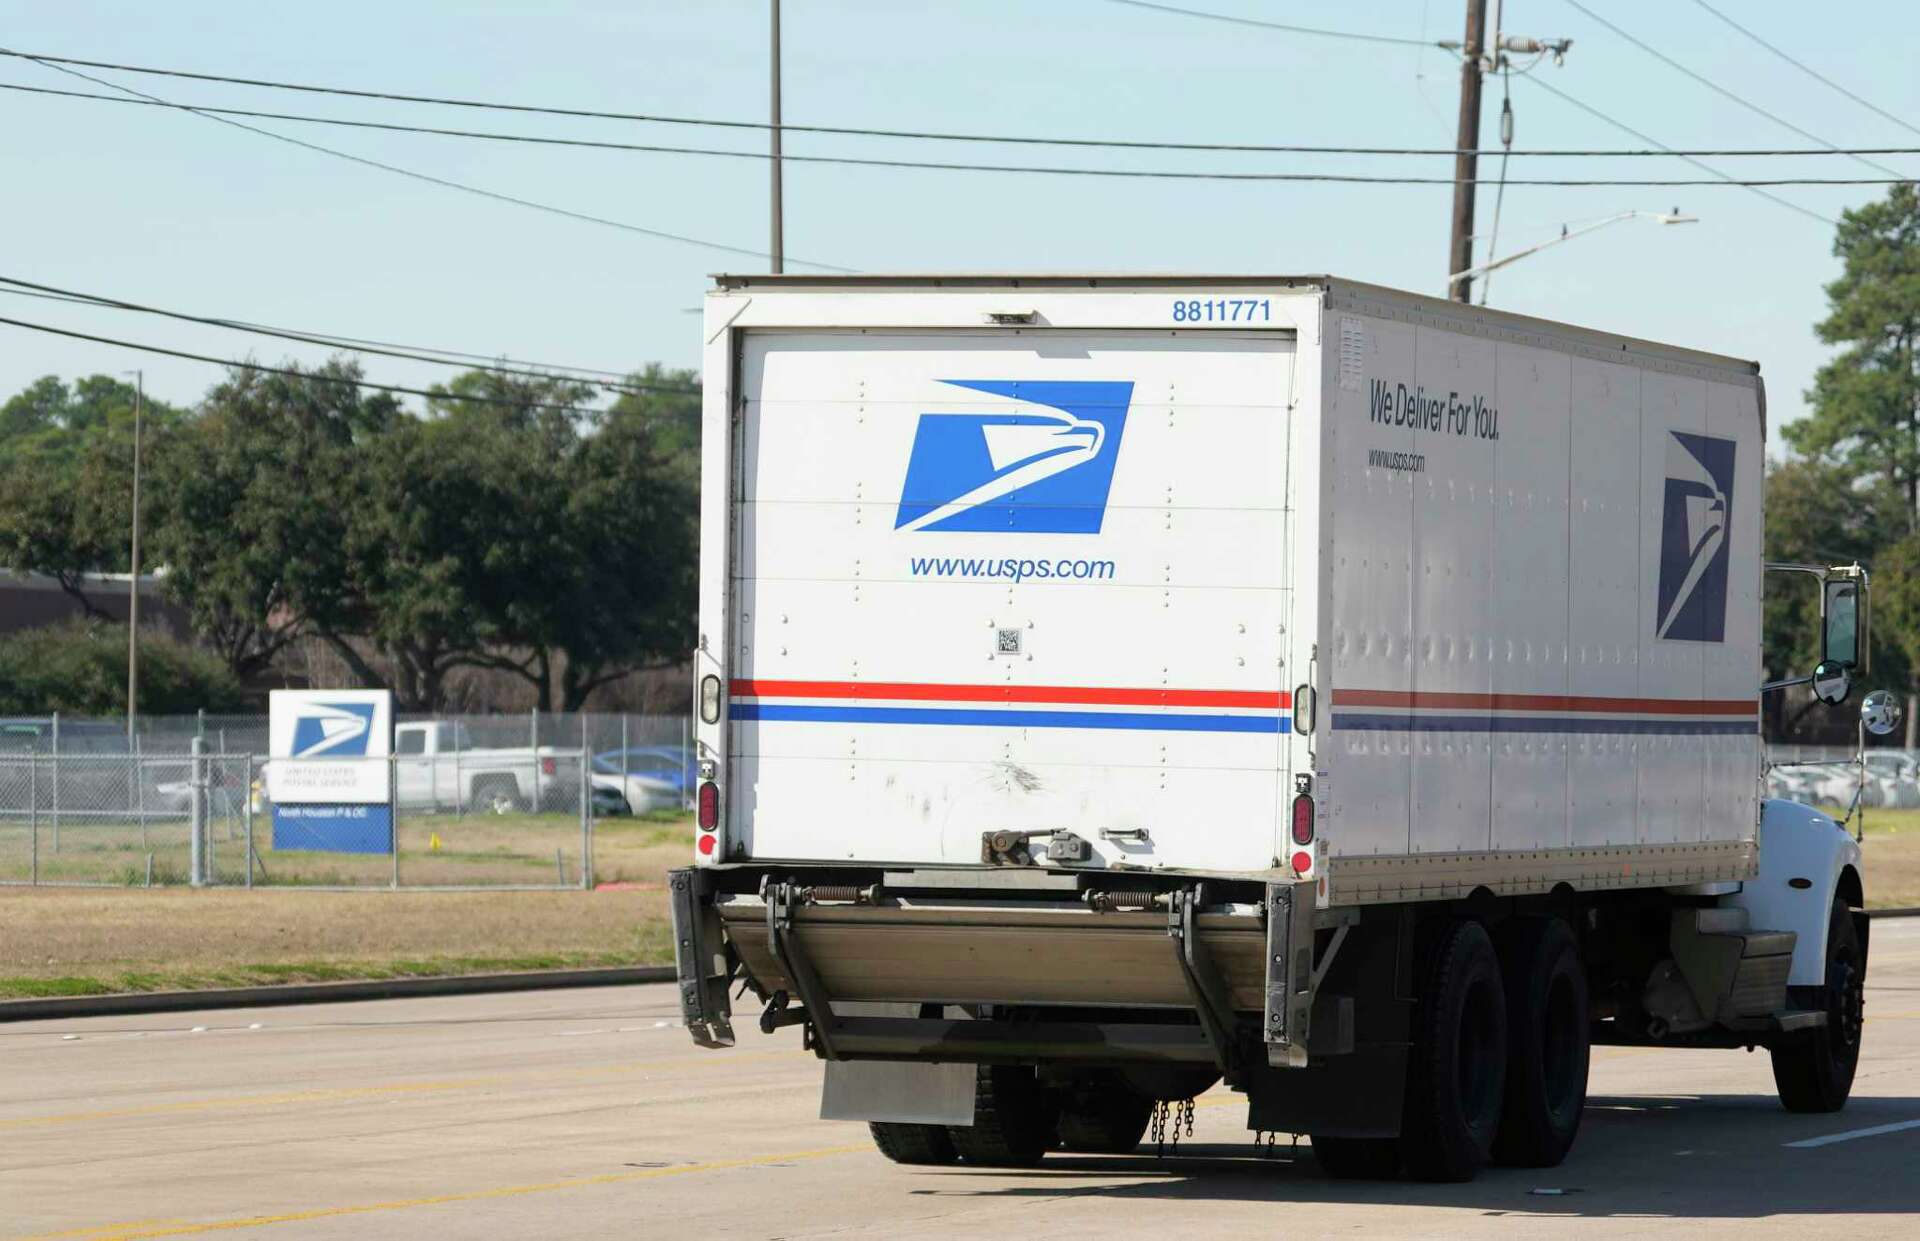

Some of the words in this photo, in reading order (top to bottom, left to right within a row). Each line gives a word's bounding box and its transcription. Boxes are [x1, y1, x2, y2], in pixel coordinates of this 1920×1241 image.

[1173, 300, 1269, 322] 8811771
[1370, 378, 1393, 425] We
[1395, 383, 1445, 432] Deliver
[1448, 392, 1471, 435] For
[1473, 395, 1499, 440] You.
[1368, 450, 1425, 474] www.usps.com
[911, 558, 1115, 584] www.usps.com
